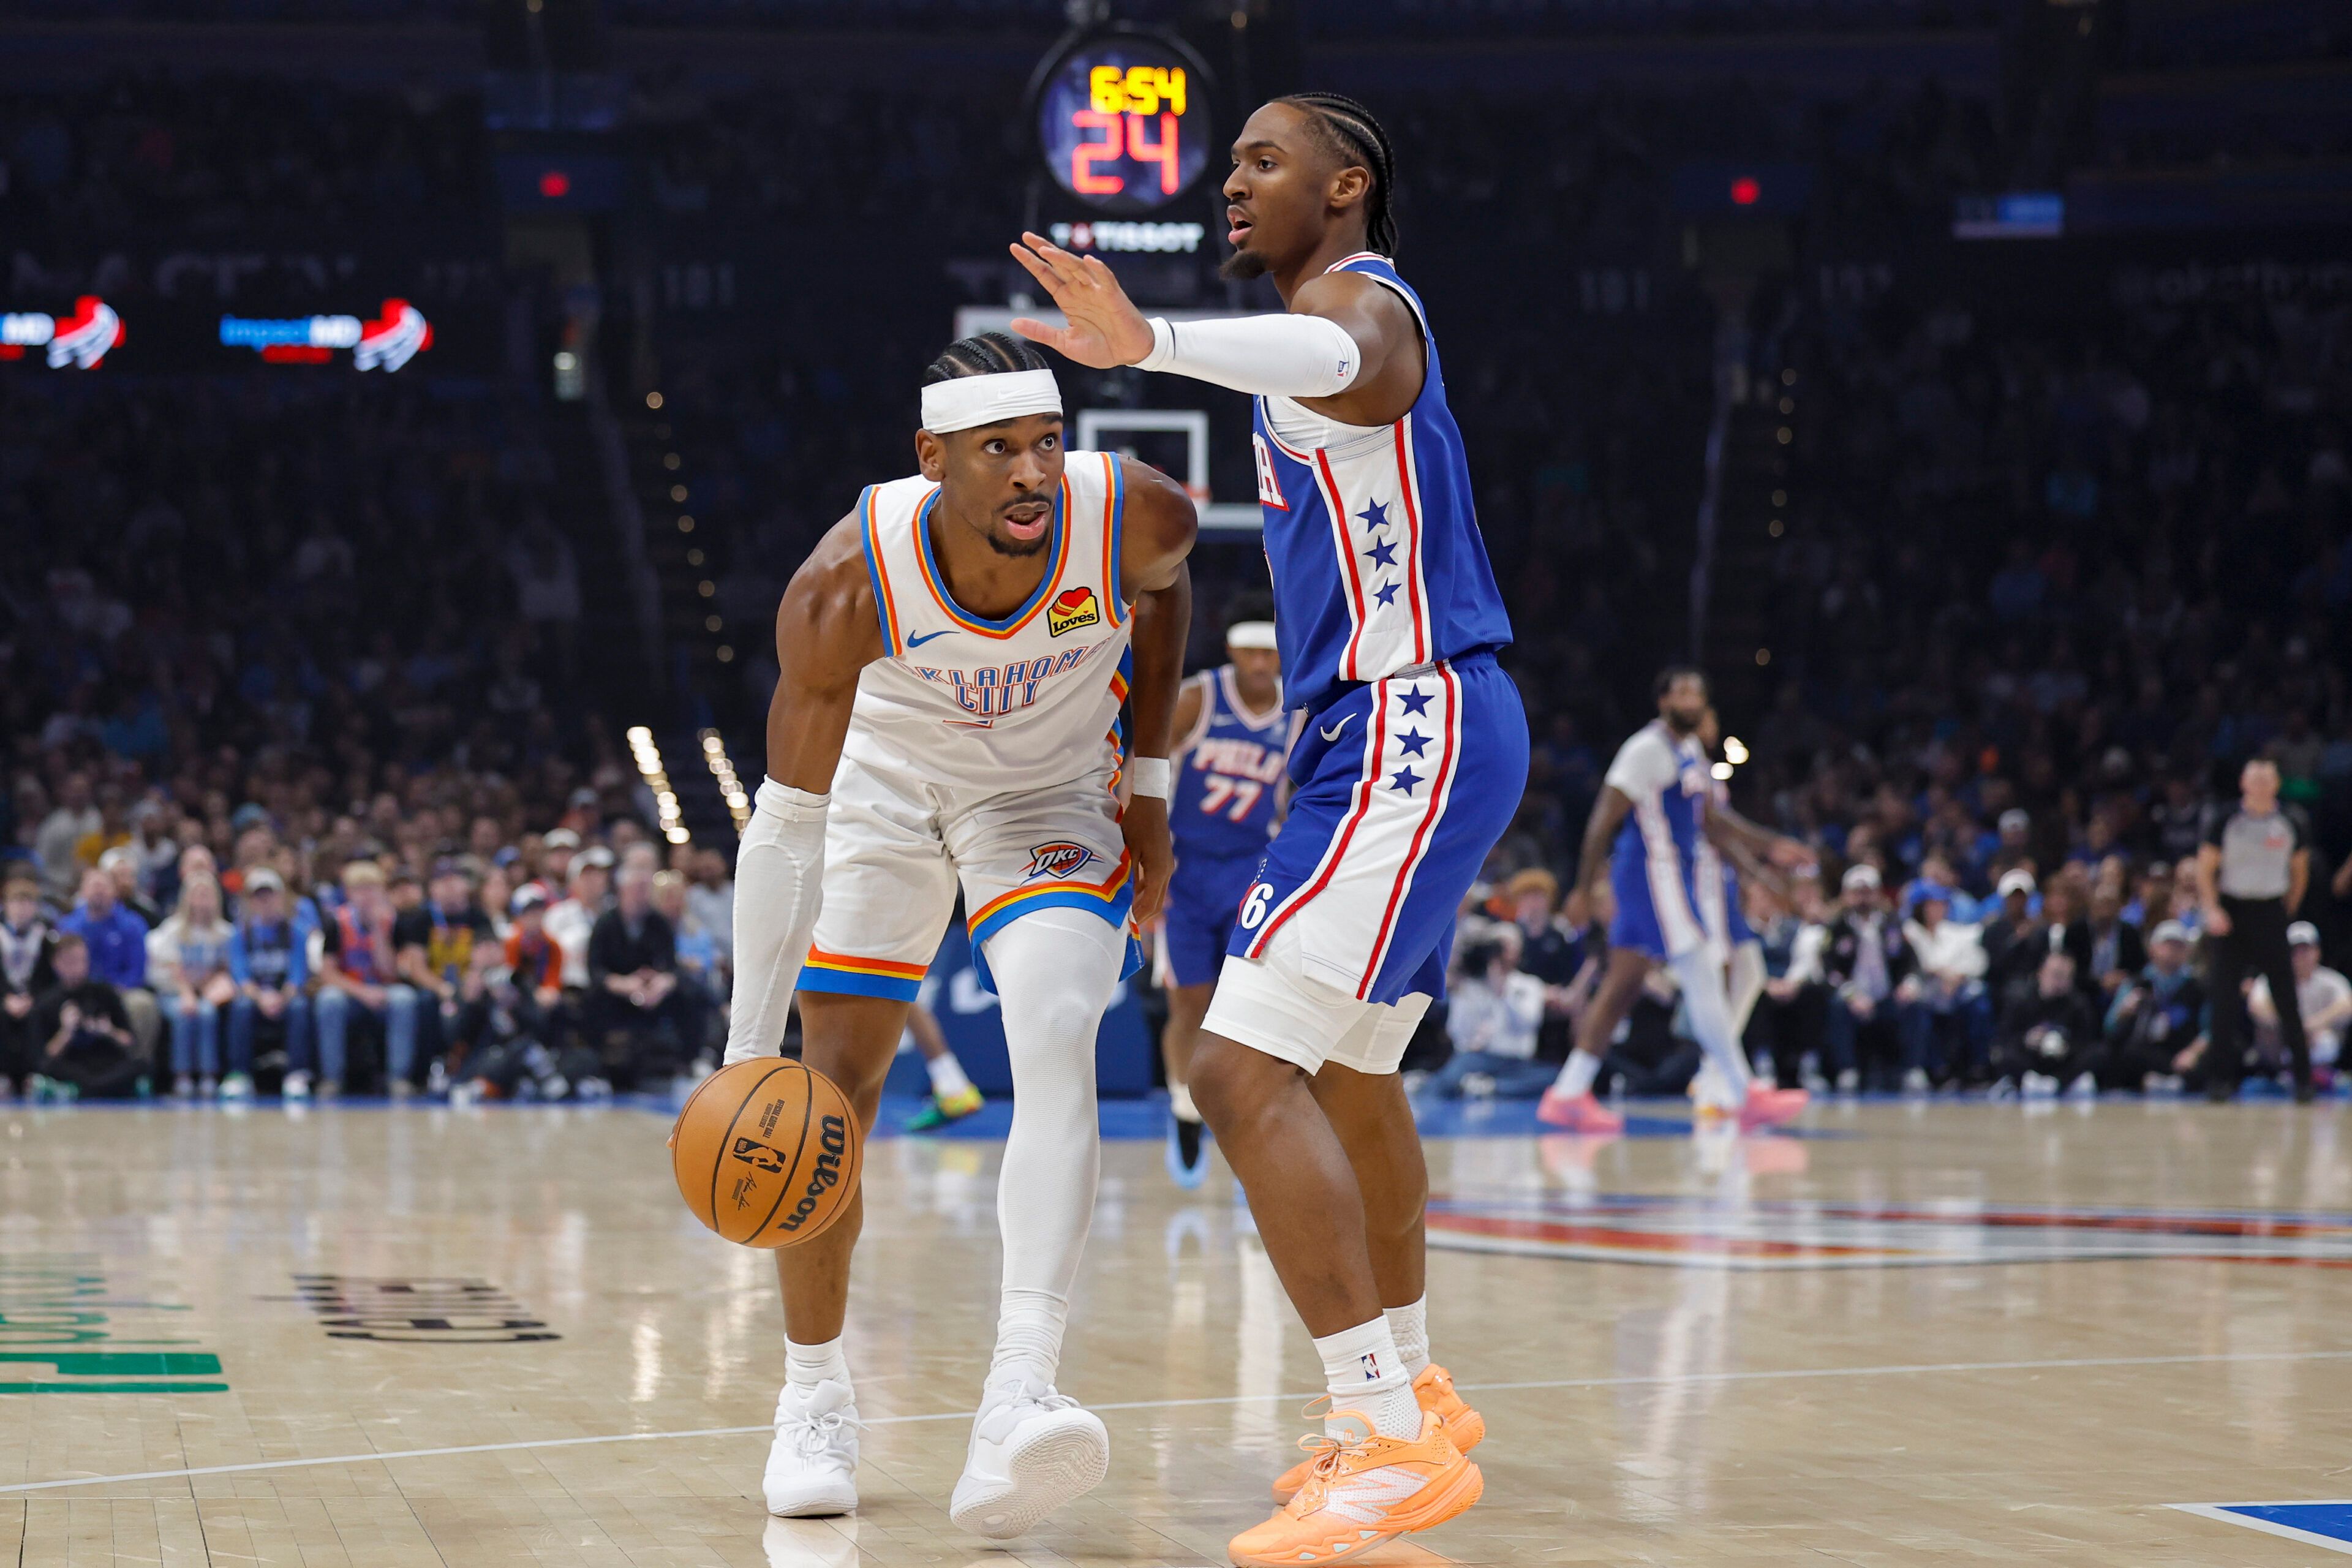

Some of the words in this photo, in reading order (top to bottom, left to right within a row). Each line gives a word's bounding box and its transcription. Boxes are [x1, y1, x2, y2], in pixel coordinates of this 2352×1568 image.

[1090, 66, 1186, 116] 6:54
[1072, 110, 1180, 195] 24
[890, 637, 1110, 688] KLAHOM
[1200, 774, 1262, 822] 77
[1030, 848, 1079, 876] OKC
[777, 1114, 845, 1232] Wilson
